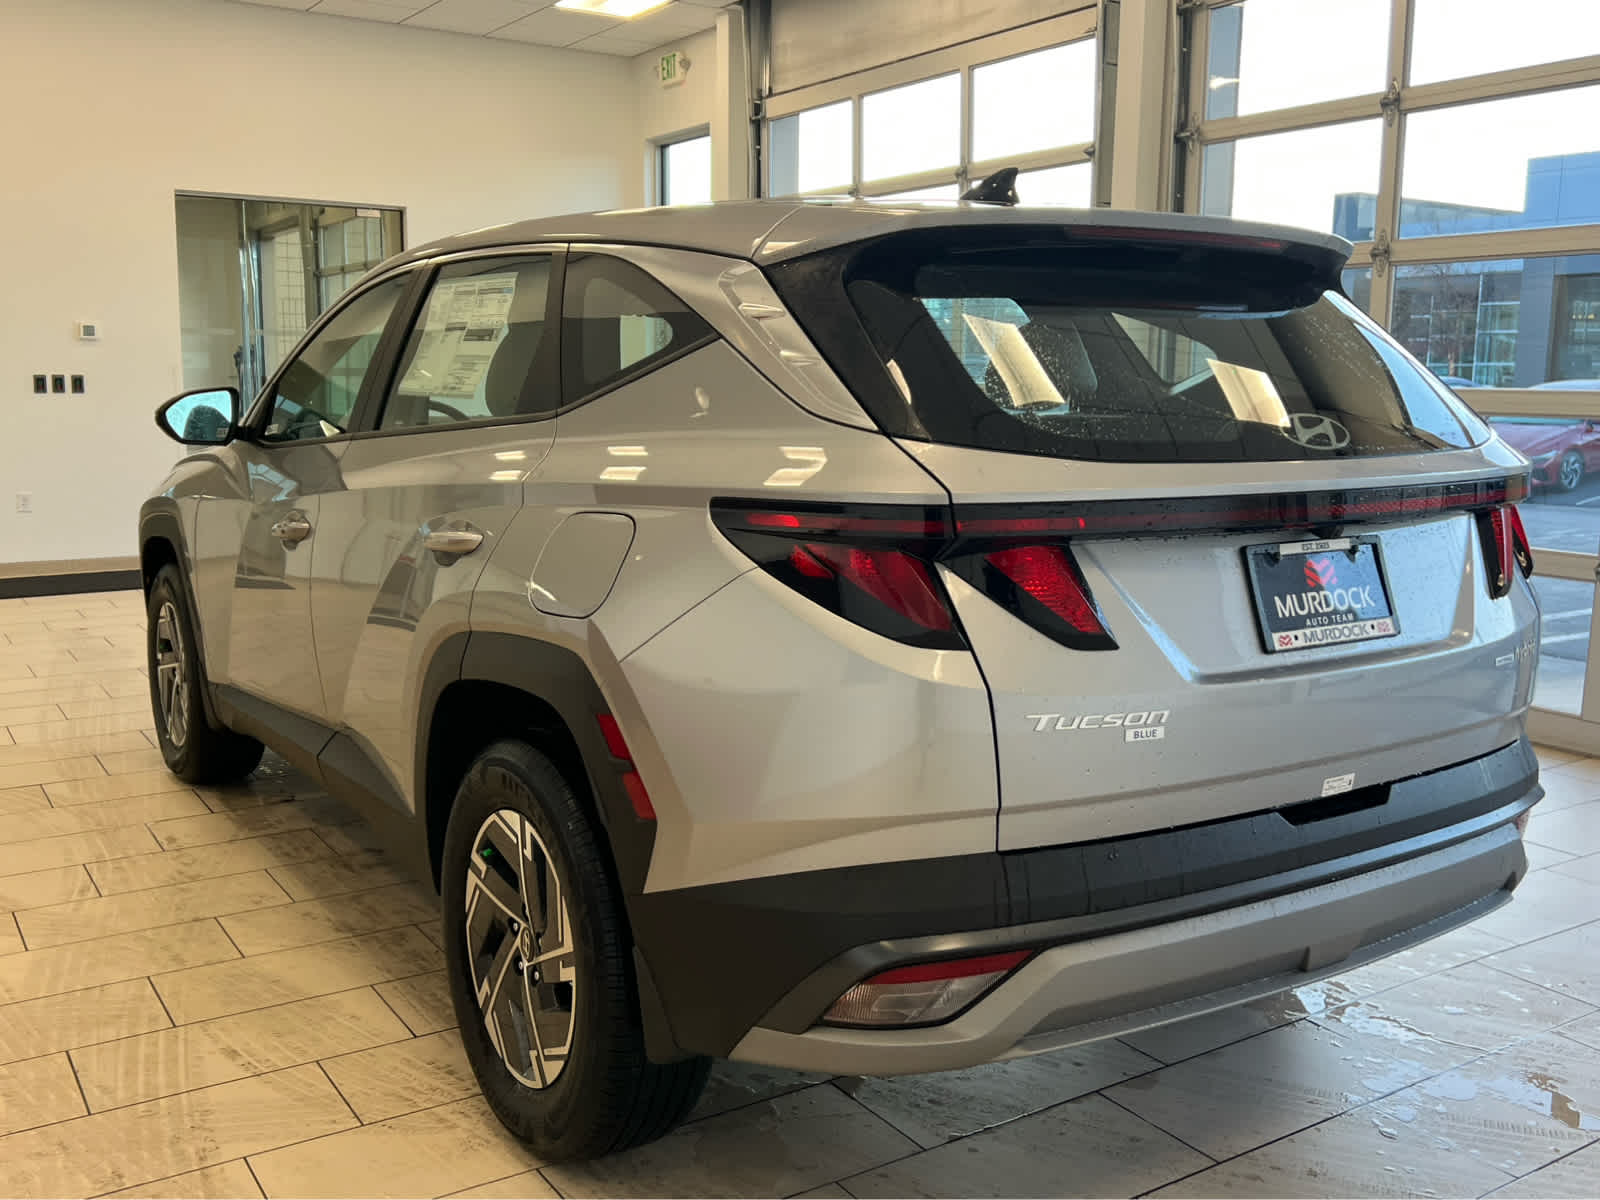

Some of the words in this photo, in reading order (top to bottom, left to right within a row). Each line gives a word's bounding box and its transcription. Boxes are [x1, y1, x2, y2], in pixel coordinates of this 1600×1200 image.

[661, 53, 677, 81] EXIT
[1274, 585, 1376, 618] MURDOCK
[1305, 616, 1329, 626] AUTO
[1331, 612, 1355, 624] TEAM
[1303, 624, 1368, 644] MURDOCK
[1132, 728, 1158, 740] BLUE
